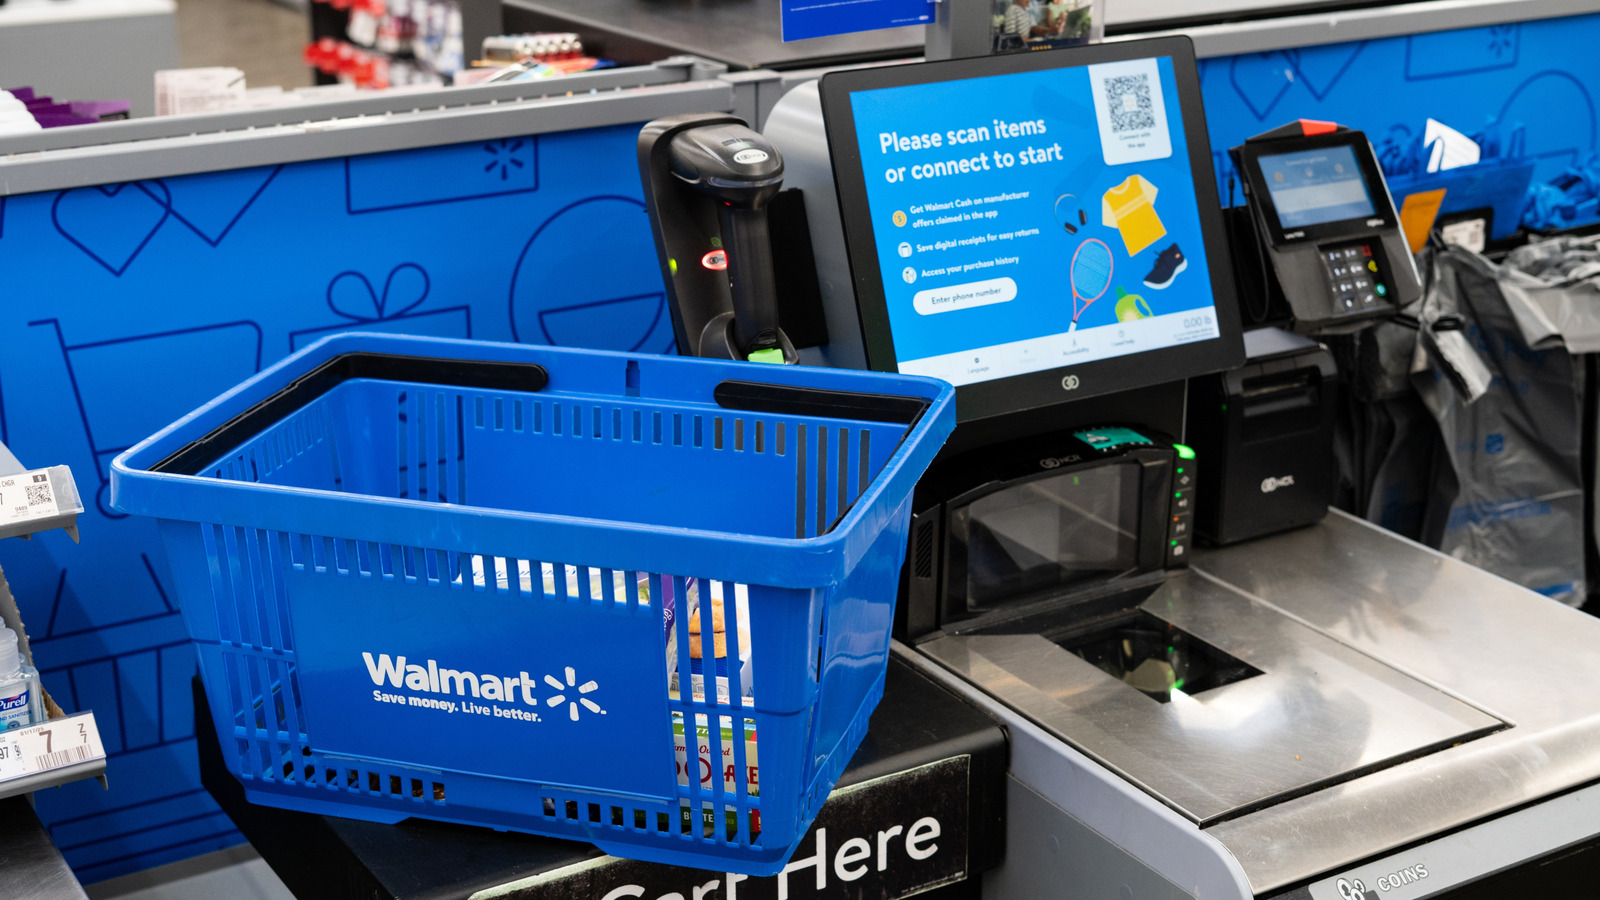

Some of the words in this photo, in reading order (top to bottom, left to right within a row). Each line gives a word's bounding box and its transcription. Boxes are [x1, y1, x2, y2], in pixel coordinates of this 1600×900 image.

[879, 131, 942, 154] Please
[947, 126, 990, 146] scan
[993, 119, 1047, 139] items
[885, 167, 906, 183] or
[911, 152, 991, 179] connect
[993, 150, 1015, 168] to
[1019, 142, 1064, 165] start
[910, 205, 924, 214] Get
[925, 200, 955, 212] Walmart
[955, 198, 973, 208] Cash
[984, 191, 1030, 204] manufacturer
[913, 219, 935, 229] offers
[936, 214, 963, 226] claimed
[964, 213, 971, 221] in
[972, 210, 984, 220] the
[985, 209, 998, 220] app
[916, 244, 935, 253] Save
[935, 239, 957, 251] digital
[958, 236, 987, 249] receipts
[987, 233, 998, 242] for
[999, 232, 1014, 243] easy
[1015, 228, 1040, 239] returns
[921, 268, 947, 278] Access
[947, 265, 963, 275] your
[964, 260, 995, 273] purchase
[995, 256, 1020, 269] history
[932, 295, 951, 305] Enter
[953, 292, 975, 304] phone
[976, 287, 1002, 299] number
[1183, 316, 1203, 329] 0.00
[967, 366, 990, 375] Language
[1059, 454, 1083, 464] NCR
[362, 651, 538, 706] Walmart
[373, 690, 407, 705] Save
[409, 693, 460, 713] money.
[462, 701, 491, 716] Live
[493, 704, 542, 723] better.
[38, 730, 52, 754] 7
[778, 817, 941, 900] Here
[1377, 863, 1429, 892] COINS
